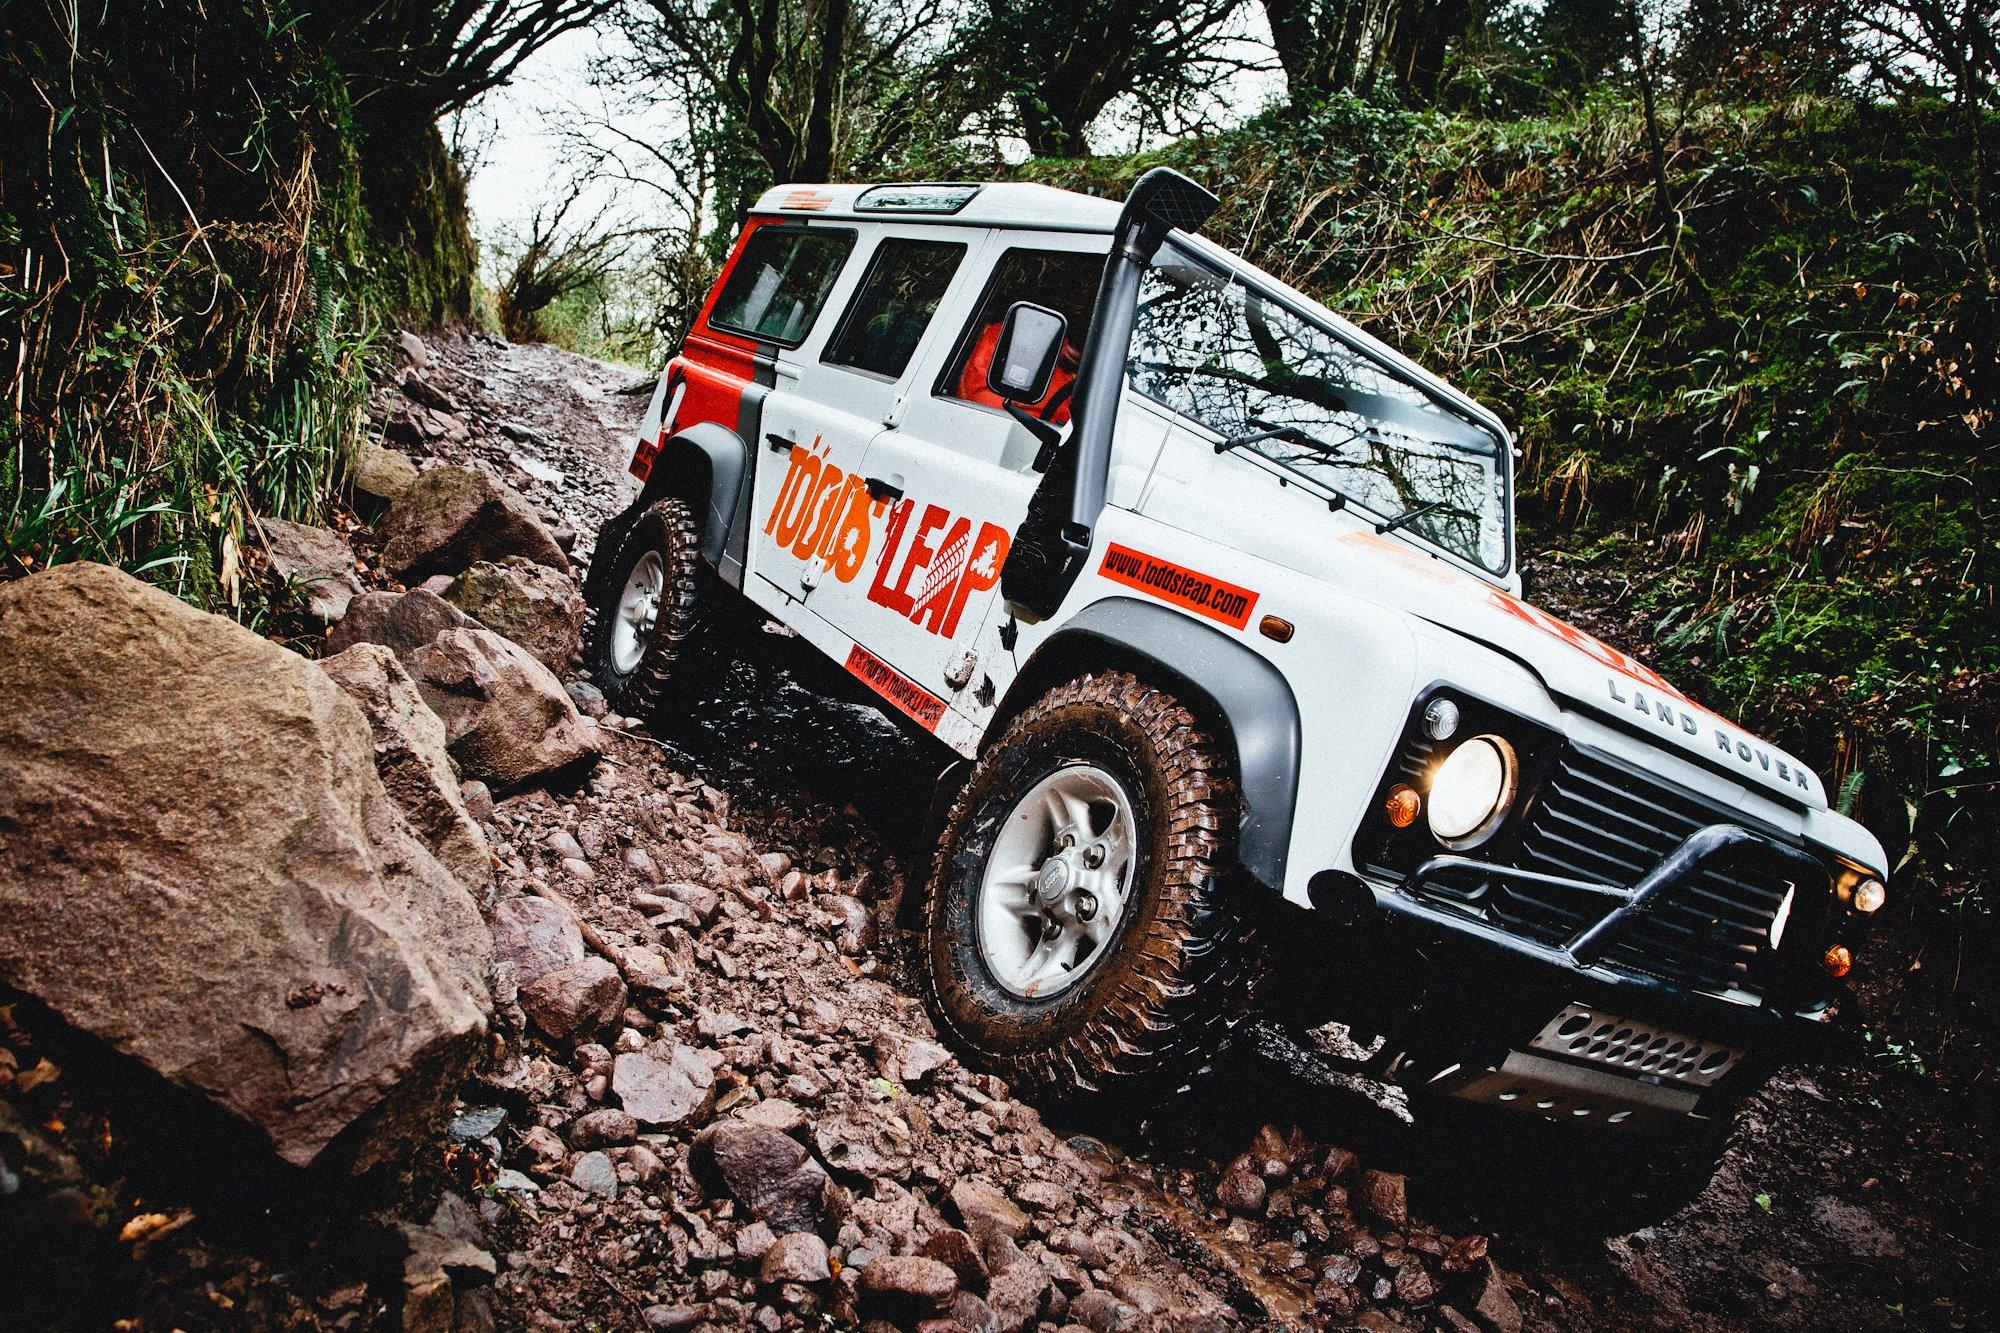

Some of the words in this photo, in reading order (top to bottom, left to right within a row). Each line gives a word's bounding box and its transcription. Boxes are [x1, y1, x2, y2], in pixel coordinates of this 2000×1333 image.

[867, 497, 1010, 639] LEAP
[1105, 550, 1248, 619] www.toddsleap.com
[1608, 679, 1697, 736] LAND
[1714, 729, 1809, 791] ROVER
